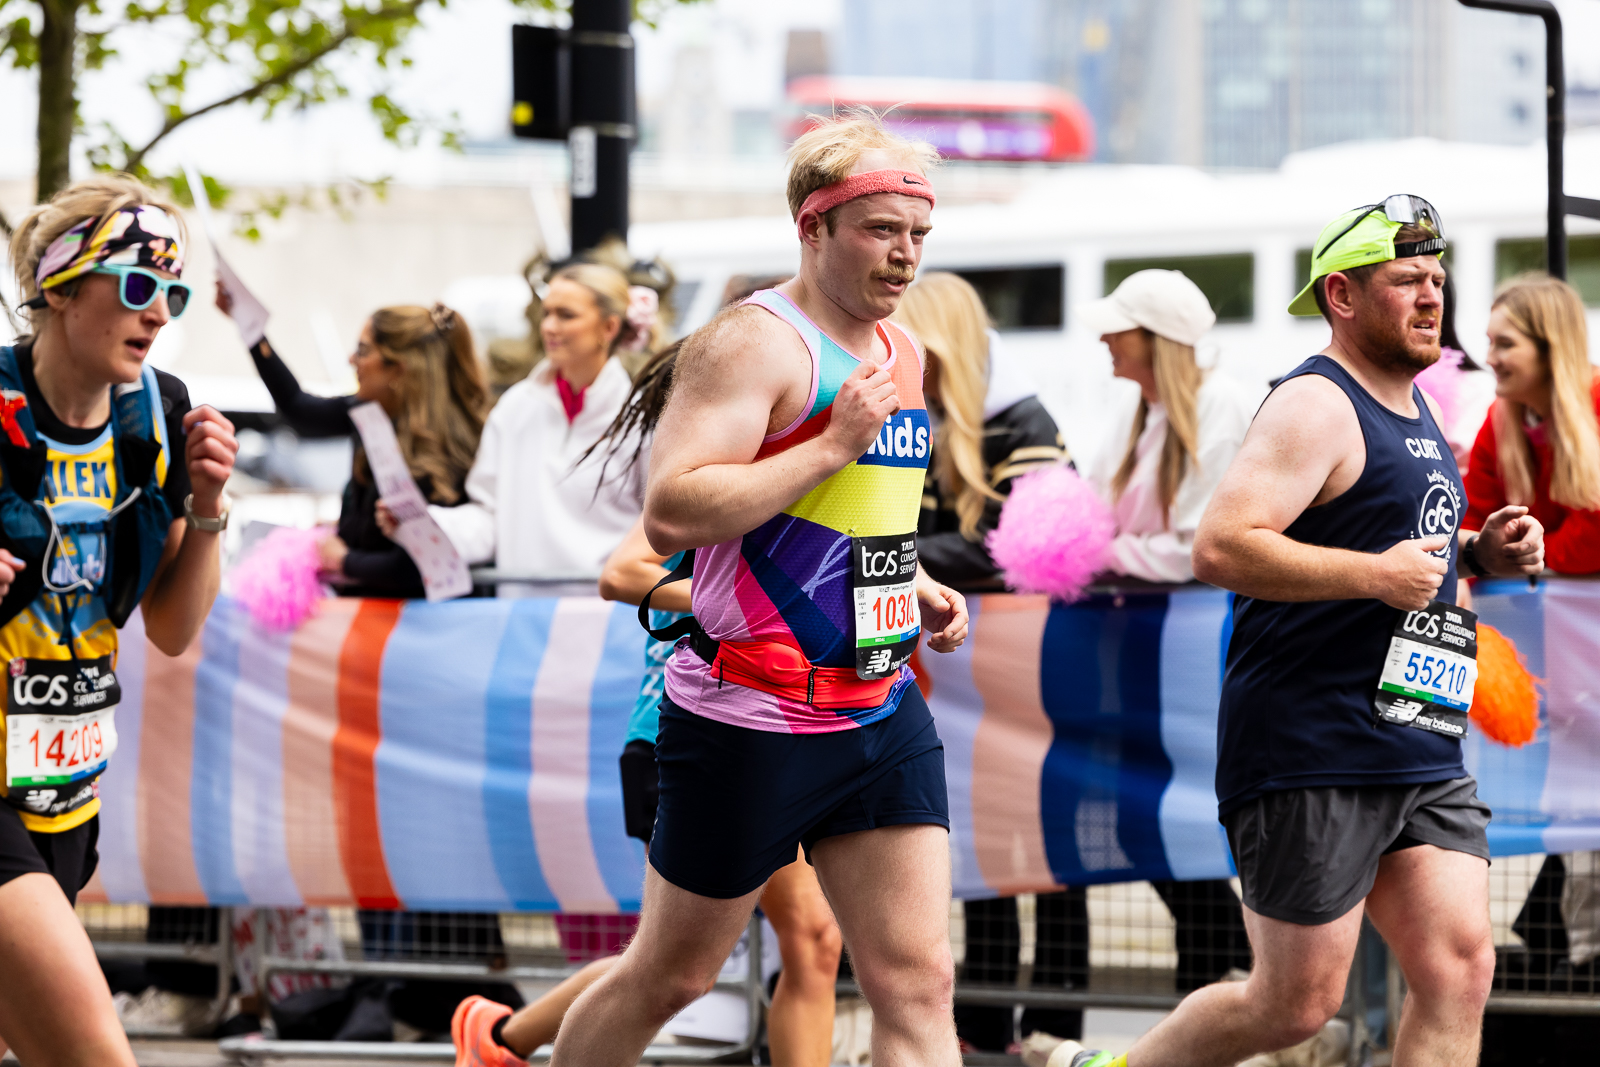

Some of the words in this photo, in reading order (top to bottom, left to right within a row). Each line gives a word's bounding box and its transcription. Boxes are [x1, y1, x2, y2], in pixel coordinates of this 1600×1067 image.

[1405, 438, 1442, 460] CURT
[861, 545, 898, 578] tcs
[1403, 610, 1440, 639] tcs
[1445, 611, 1462, 624] TATA
[1440, 632, 1467, 647] SERVICES
[1404, 652, 1467, 695] 55210
[13, 674, 69, 706] tcs
[1416, 715, 1433, 726] new
[1432, 717, 1464, 734] balance
[29, 721, 103, 768] 14209
